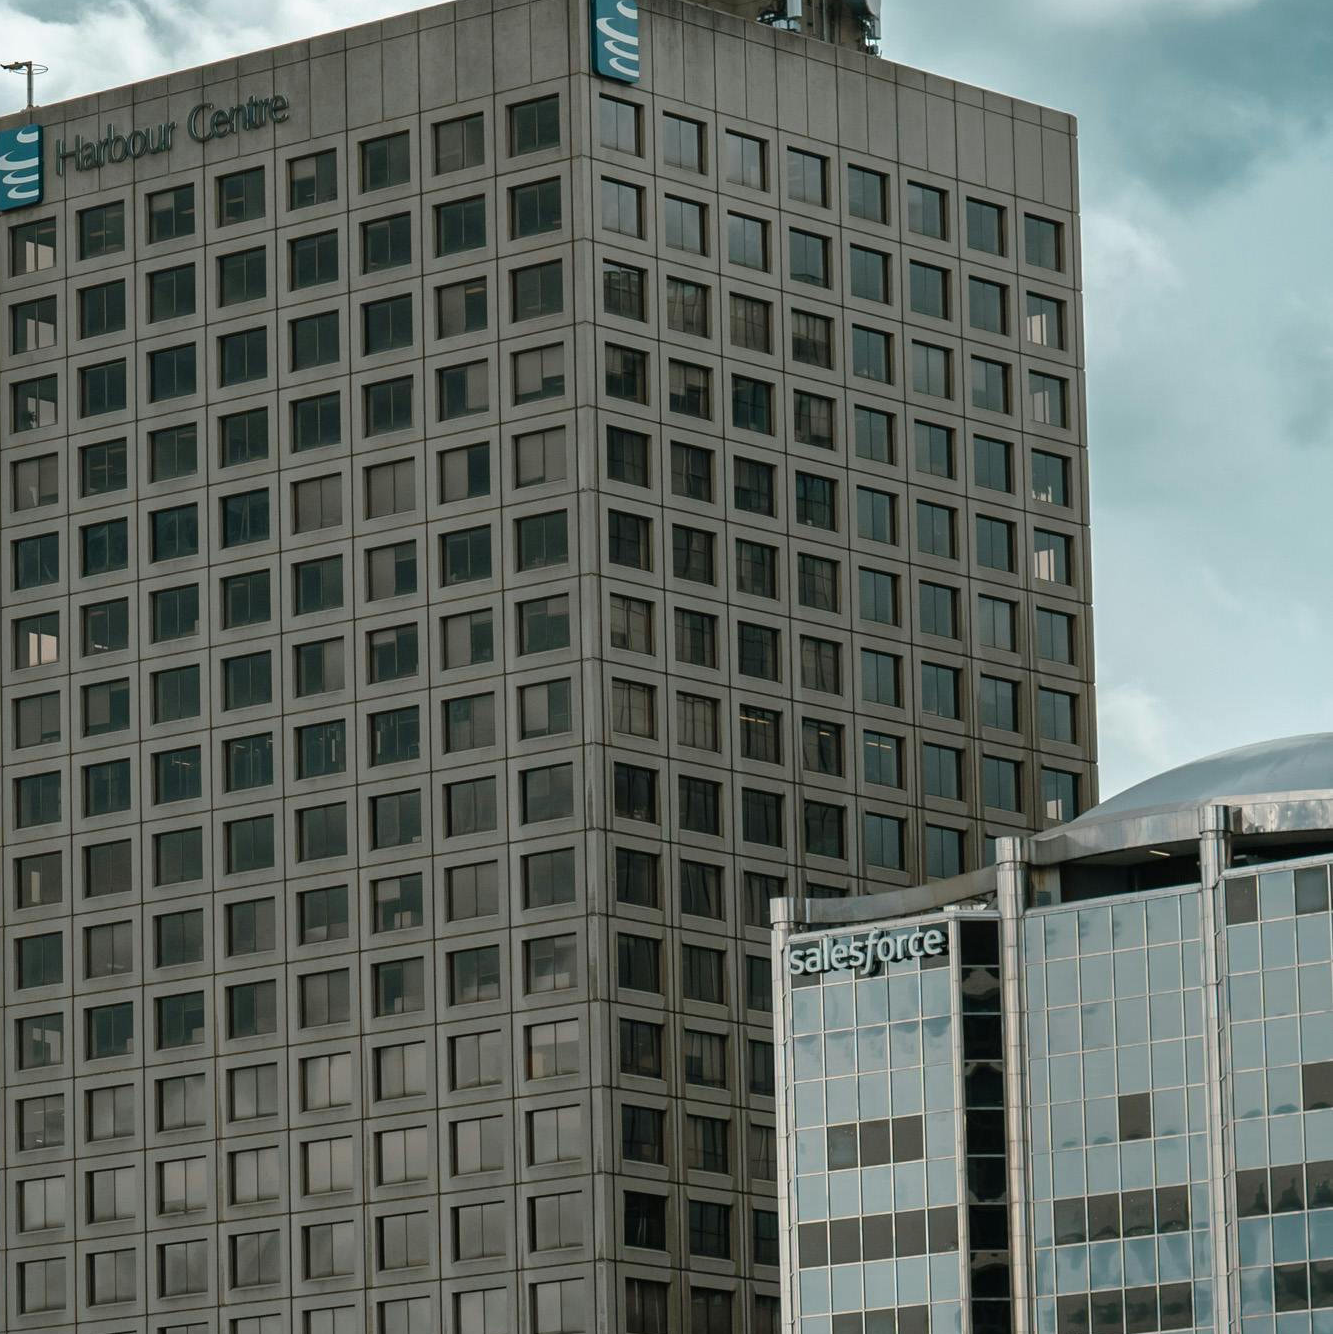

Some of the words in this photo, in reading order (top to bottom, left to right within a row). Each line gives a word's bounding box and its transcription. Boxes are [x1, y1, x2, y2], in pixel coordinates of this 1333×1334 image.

[55, 119, 177, 177] Harbour
[186, 94, 290, 143] Centre
[789, 928, 944, 975] salesforce
